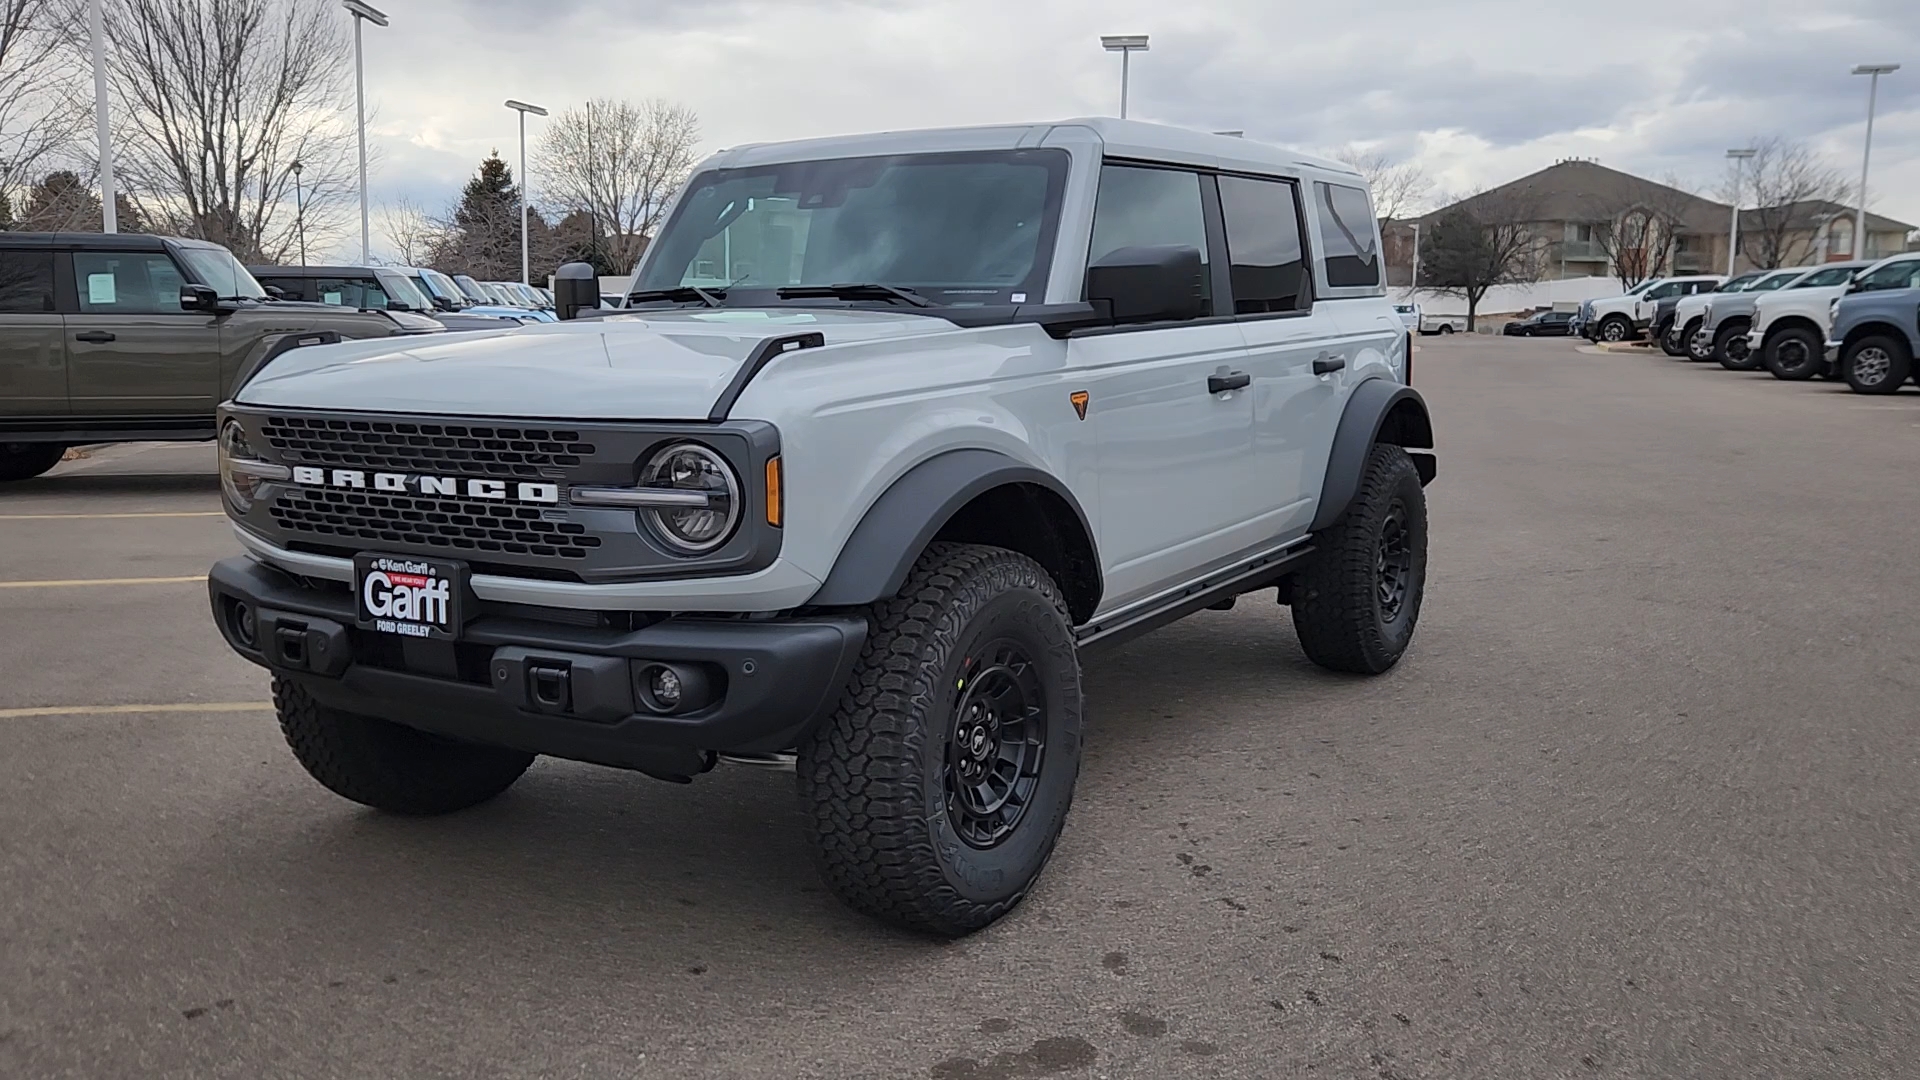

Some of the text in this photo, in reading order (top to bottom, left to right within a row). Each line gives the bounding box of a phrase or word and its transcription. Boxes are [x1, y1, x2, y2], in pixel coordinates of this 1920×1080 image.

[292, 466, 559, 503] BRONCO
[386, 559, 429, 575] Ken Garff
[364, 571, 450, 625] Garff
[376, 620, 430, 637] FORD GREELEY
